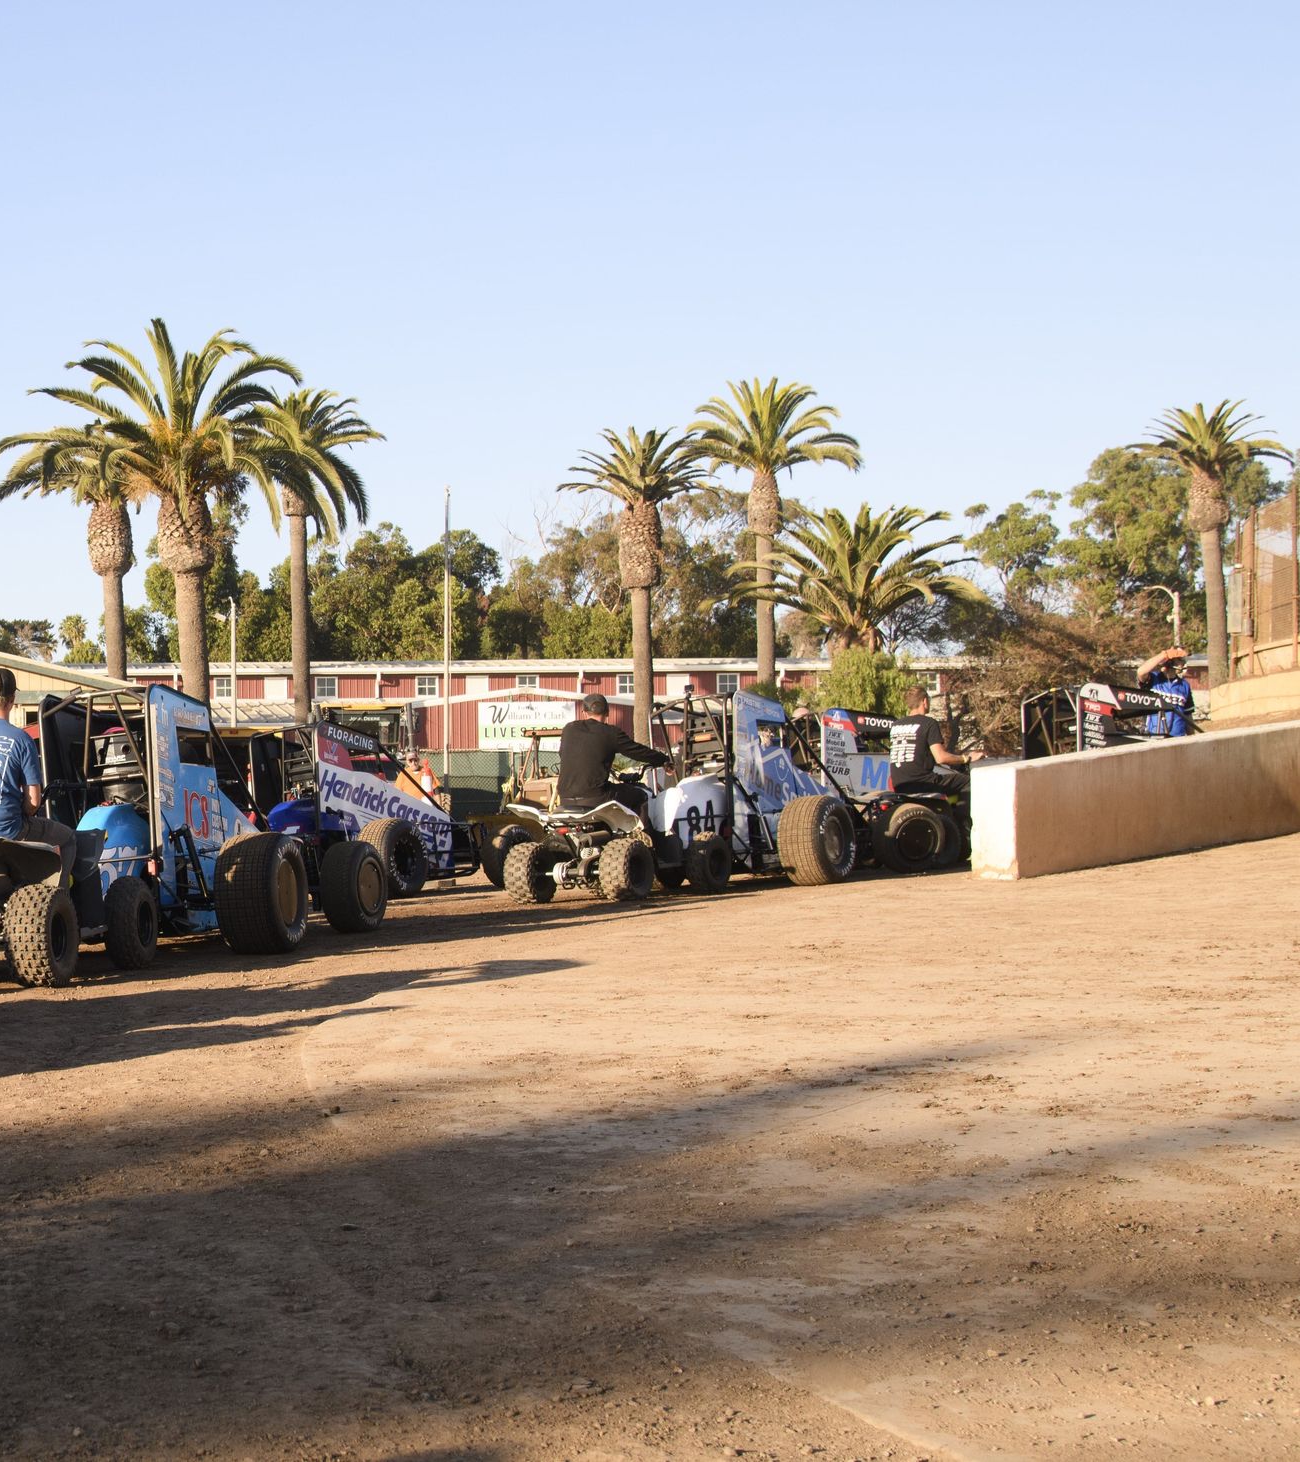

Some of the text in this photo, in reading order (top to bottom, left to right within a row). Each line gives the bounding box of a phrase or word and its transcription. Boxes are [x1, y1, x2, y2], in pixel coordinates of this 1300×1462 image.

[1125, 693, 1162, 708] TOYOA
[864, 717, 894, 729] TOYOT
[327, 726, 374, 750] FLORACING
[826, 765, 851, 776] CURB
